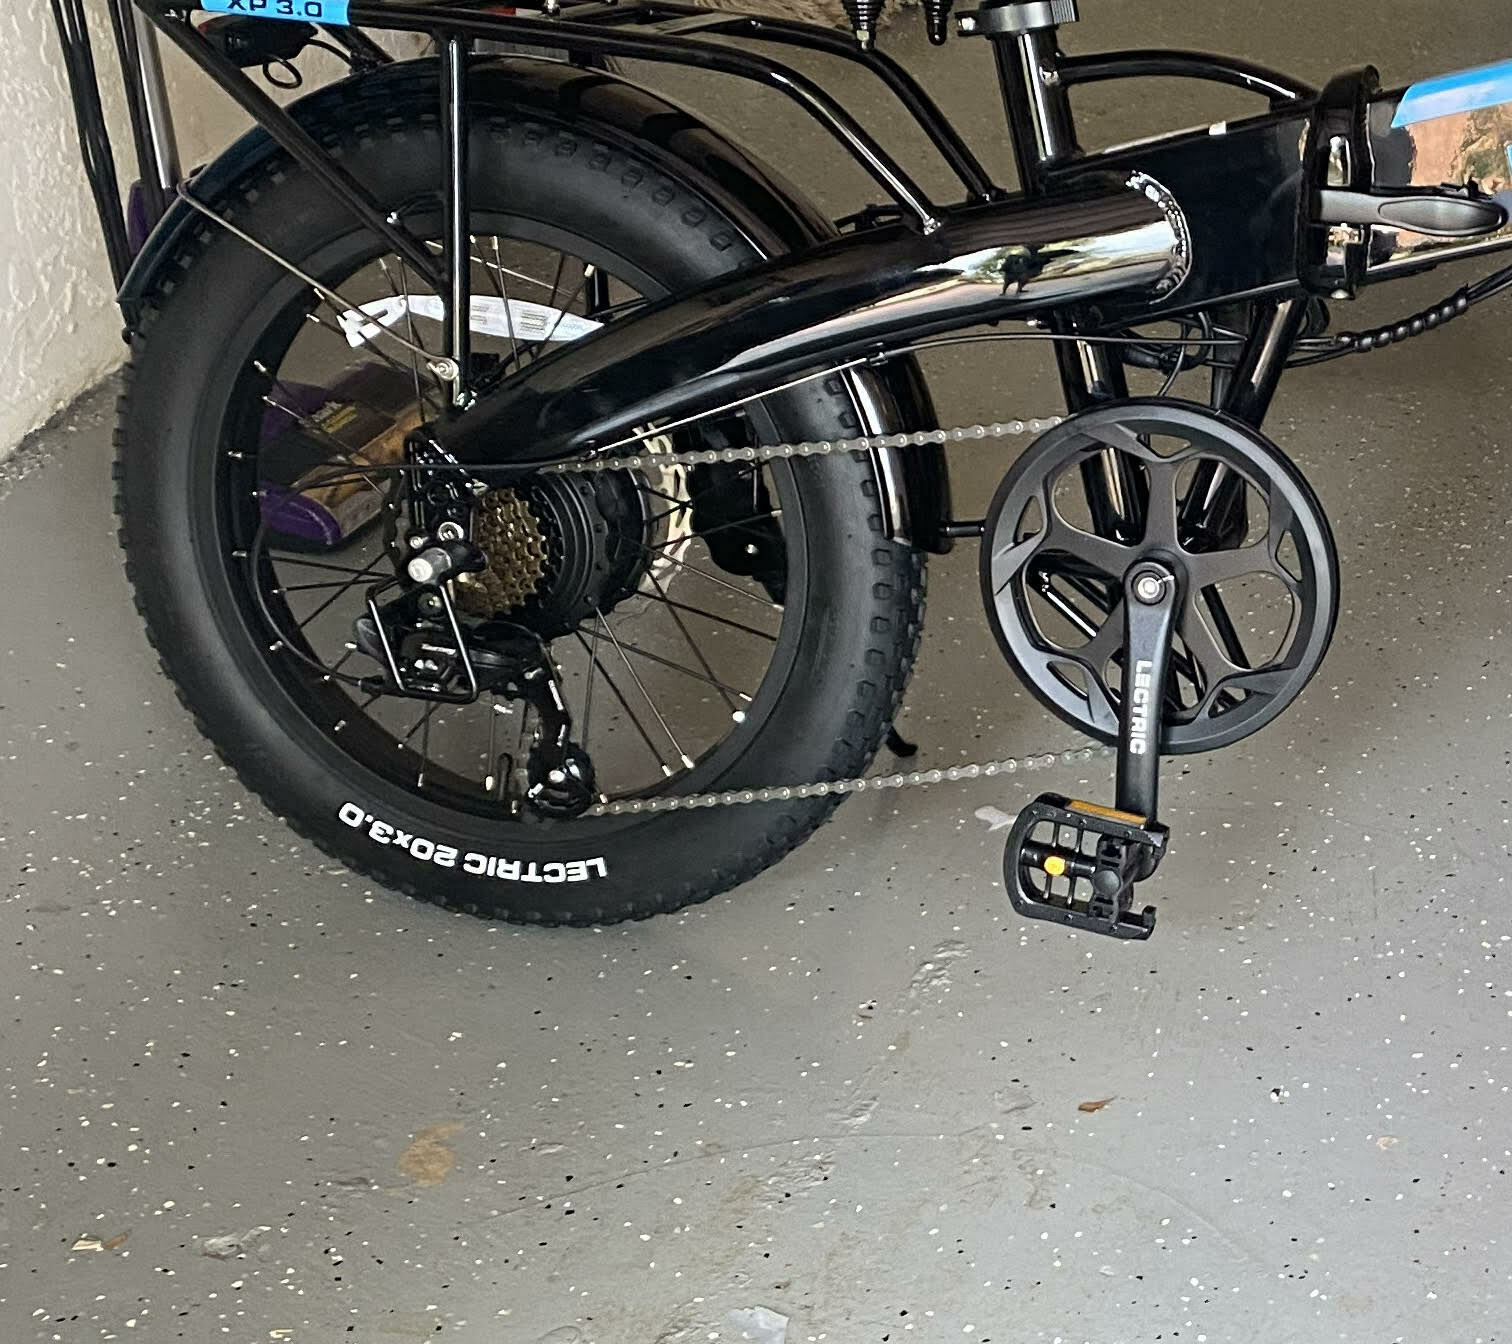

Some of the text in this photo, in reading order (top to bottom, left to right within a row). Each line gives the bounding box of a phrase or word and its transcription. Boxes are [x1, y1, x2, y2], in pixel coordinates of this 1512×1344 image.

[276, 0, 322, 17] 3.0
[1129, 660, 1153, 755] LECTRIC
[338, 802, 608, 884] LECTRIC 20x3.0
